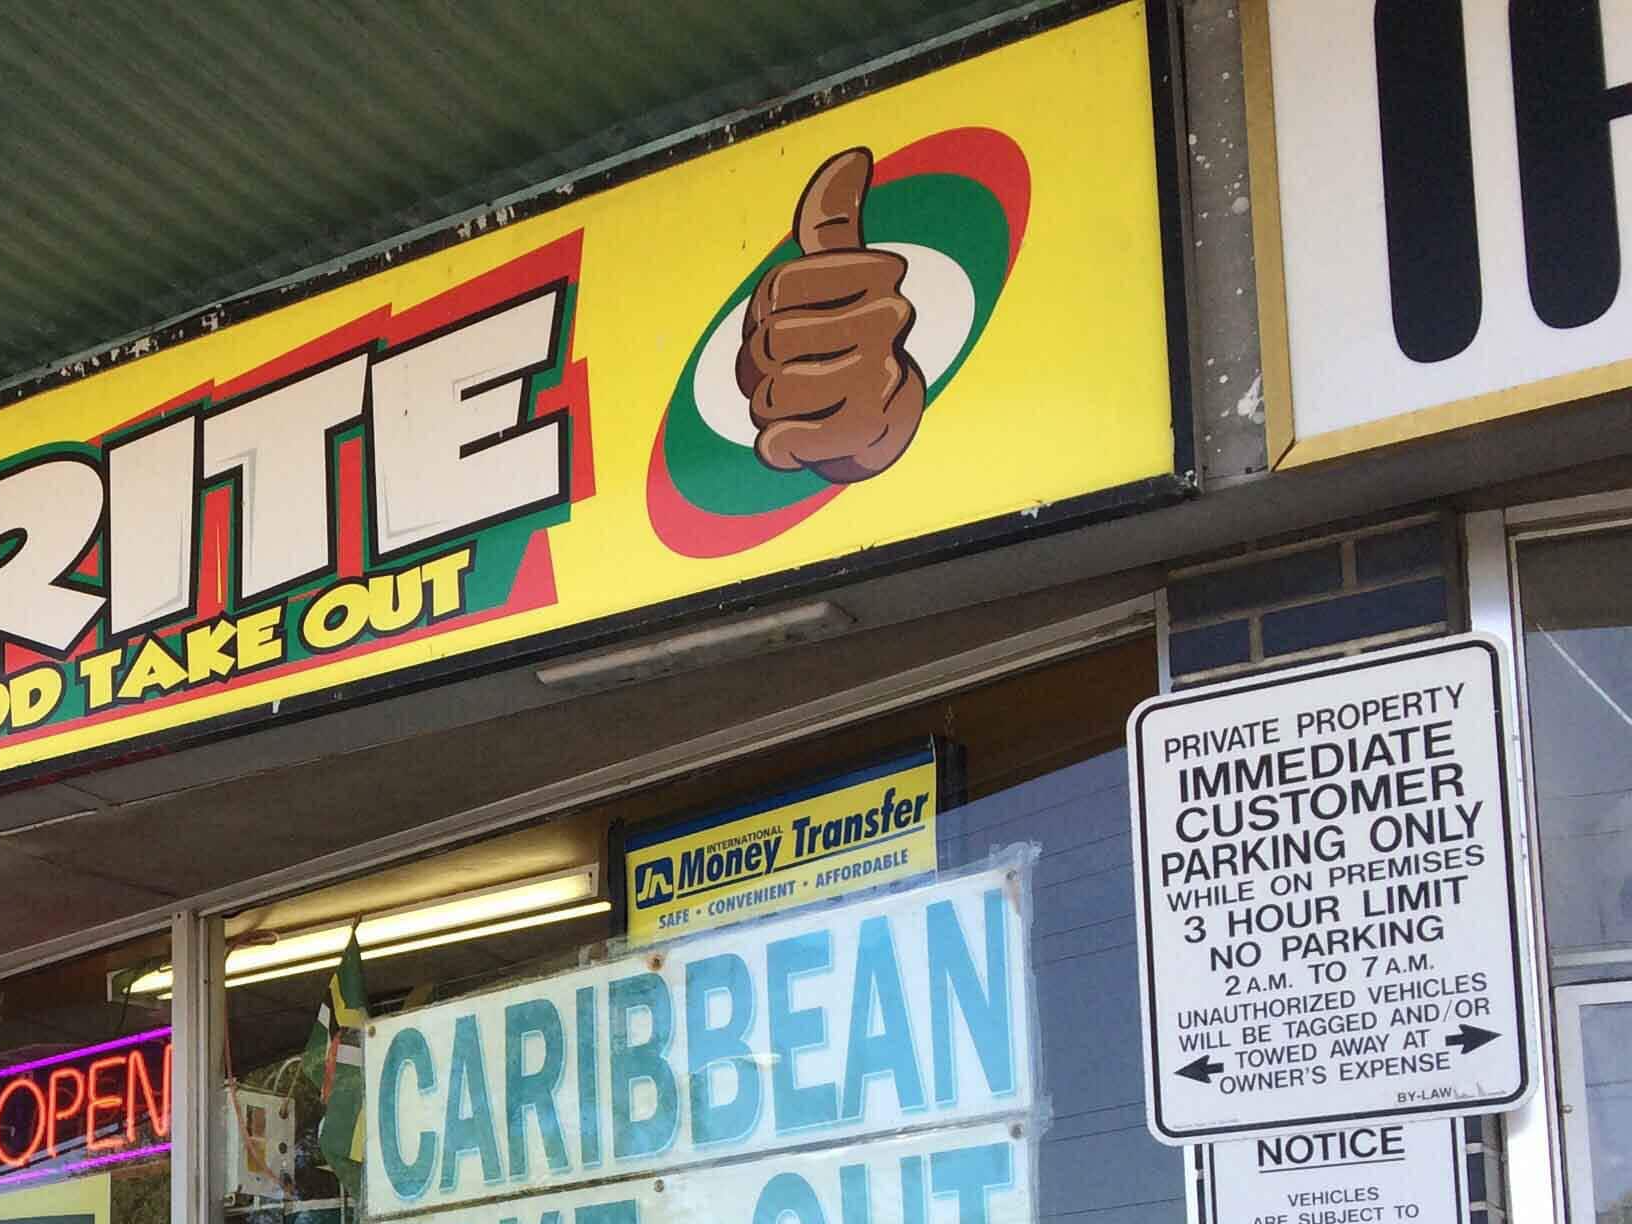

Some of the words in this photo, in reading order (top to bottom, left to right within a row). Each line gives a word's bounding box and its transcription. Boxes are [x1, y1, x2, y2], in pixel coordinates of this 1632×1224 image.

[80, 605, 283, 706] TAKE
[301, 548, 472, 654] OUT
[1164, 718, 1281, 763] PRIVATE
[1297, 683, 1465, 738] PROPERTY
[1179, 720, 1455, 803] IMMEDIATE
[1175, 762, 1465, 843] CUSTOMER
[677, 835, 783, 890] Money
[792, 787, 929, 858] Transfer
[706, 825, 784, 853] INTERNATIONAL
[1161, 825, 1346, 887] PARKING
[1370, 801, 1484, 853] ONLY
[658, 908, 690, 929] SAFE
[708, 880, 796, 916] CONVENIENT
[816, 848, 909, 888] AFFORDABLE
[1167, 881, 1256, 912] WHILE
[1270, 872, 1313, 897] ON
[1329, 844, 1486, 887] PREMISES
[1184, 916, 1207, 943] 3
[1228, 895, 1340, 938] HOUR
[1363, 875, 1469, 917] LIMIT
[1210, 942, 1262, 971] NO
[1281, 915, 1444, 962] PARKING
[1177, 990, 1356, 1030] UNAUTHORIZED
[1368, 972, 1488, 1004] VEHICLES
[1225, 975, 1242, 996] 2
[1246, 974, 1293, 995] A.M.
[1308, 962, 1347, 985] TO
[1362, 955, 1379, 977] 7
[1386, 954, 1435, 974] A.M.
[378, 888, 1015, 1200] CARIBBEAN
[1179, 1032, 1231, 1052] WILL
[1242, 1026, 1271, 1046] BE
[1284, 1012, 1378, 1040] TAGGED
[1390, 998, 1491, 1027] AND/OR
[1235, 1044, 1318, 1069] TOWED
[1329, 1034, 1390, 1058] AWAY
[1403, 1029, 1432, 1050] AT
[1220, 1065, 1328, 1094] OWNER'S
[1339, 1052, 1452, 1082] EXPENSE
[1397, 1087, 1453, 1103] BY-LAW
[1257, 1126, 1406, 1167] NOTICE
[1287, 1187, 1380, 1207] VEHICLES
[1394, 1204, 1420, 1220] TO
